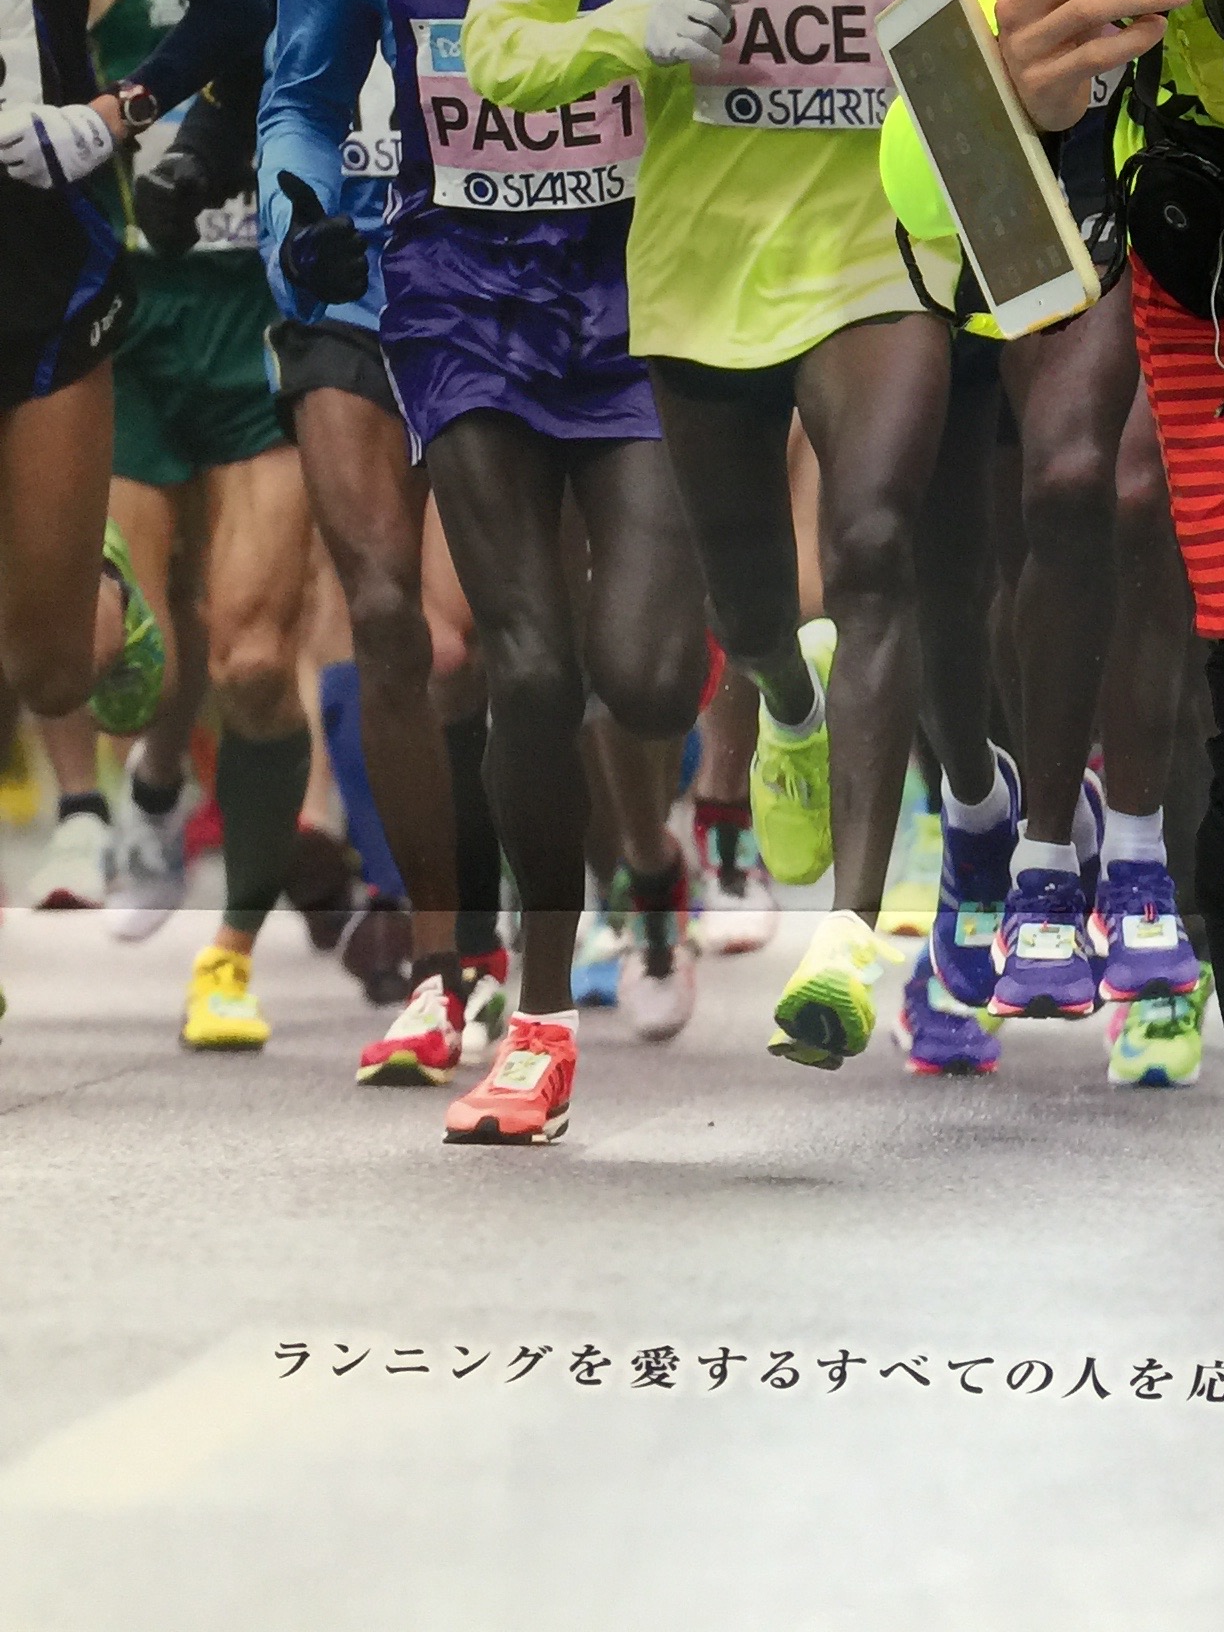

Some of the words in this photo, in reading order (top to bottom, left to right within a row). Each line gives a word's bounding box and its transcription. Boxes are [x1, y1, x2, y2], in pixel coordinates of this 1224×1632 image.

[431, 91, 602, 152] PACE
[611, 84, 634, 138] 1
[502, 164, 625, 208] STARTS
